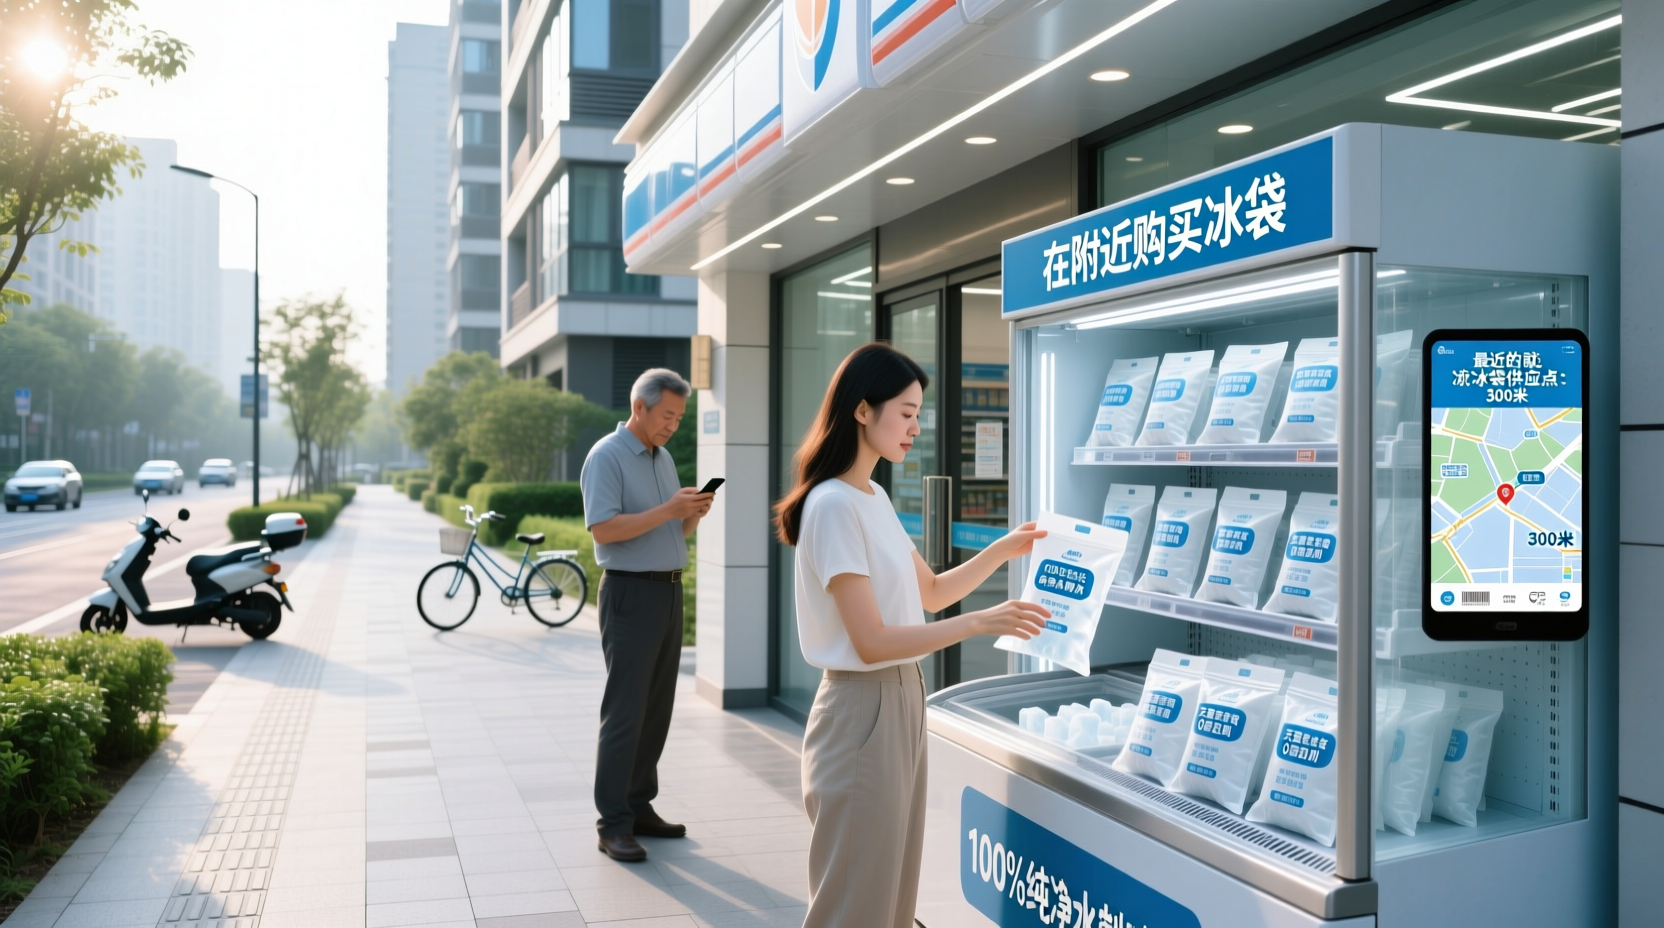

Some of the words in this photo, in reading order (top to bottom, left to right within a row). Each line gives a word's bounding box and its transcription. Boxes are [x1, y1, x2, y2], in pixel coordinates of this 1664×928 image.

[1042, 171, 1287, 292] 在附近购买冰袋
[1486, 387, 1529, 403] 300米
[1527, 530, 1575, 548] 300米
[968, 828, 1149, 928] 100%纯净水
